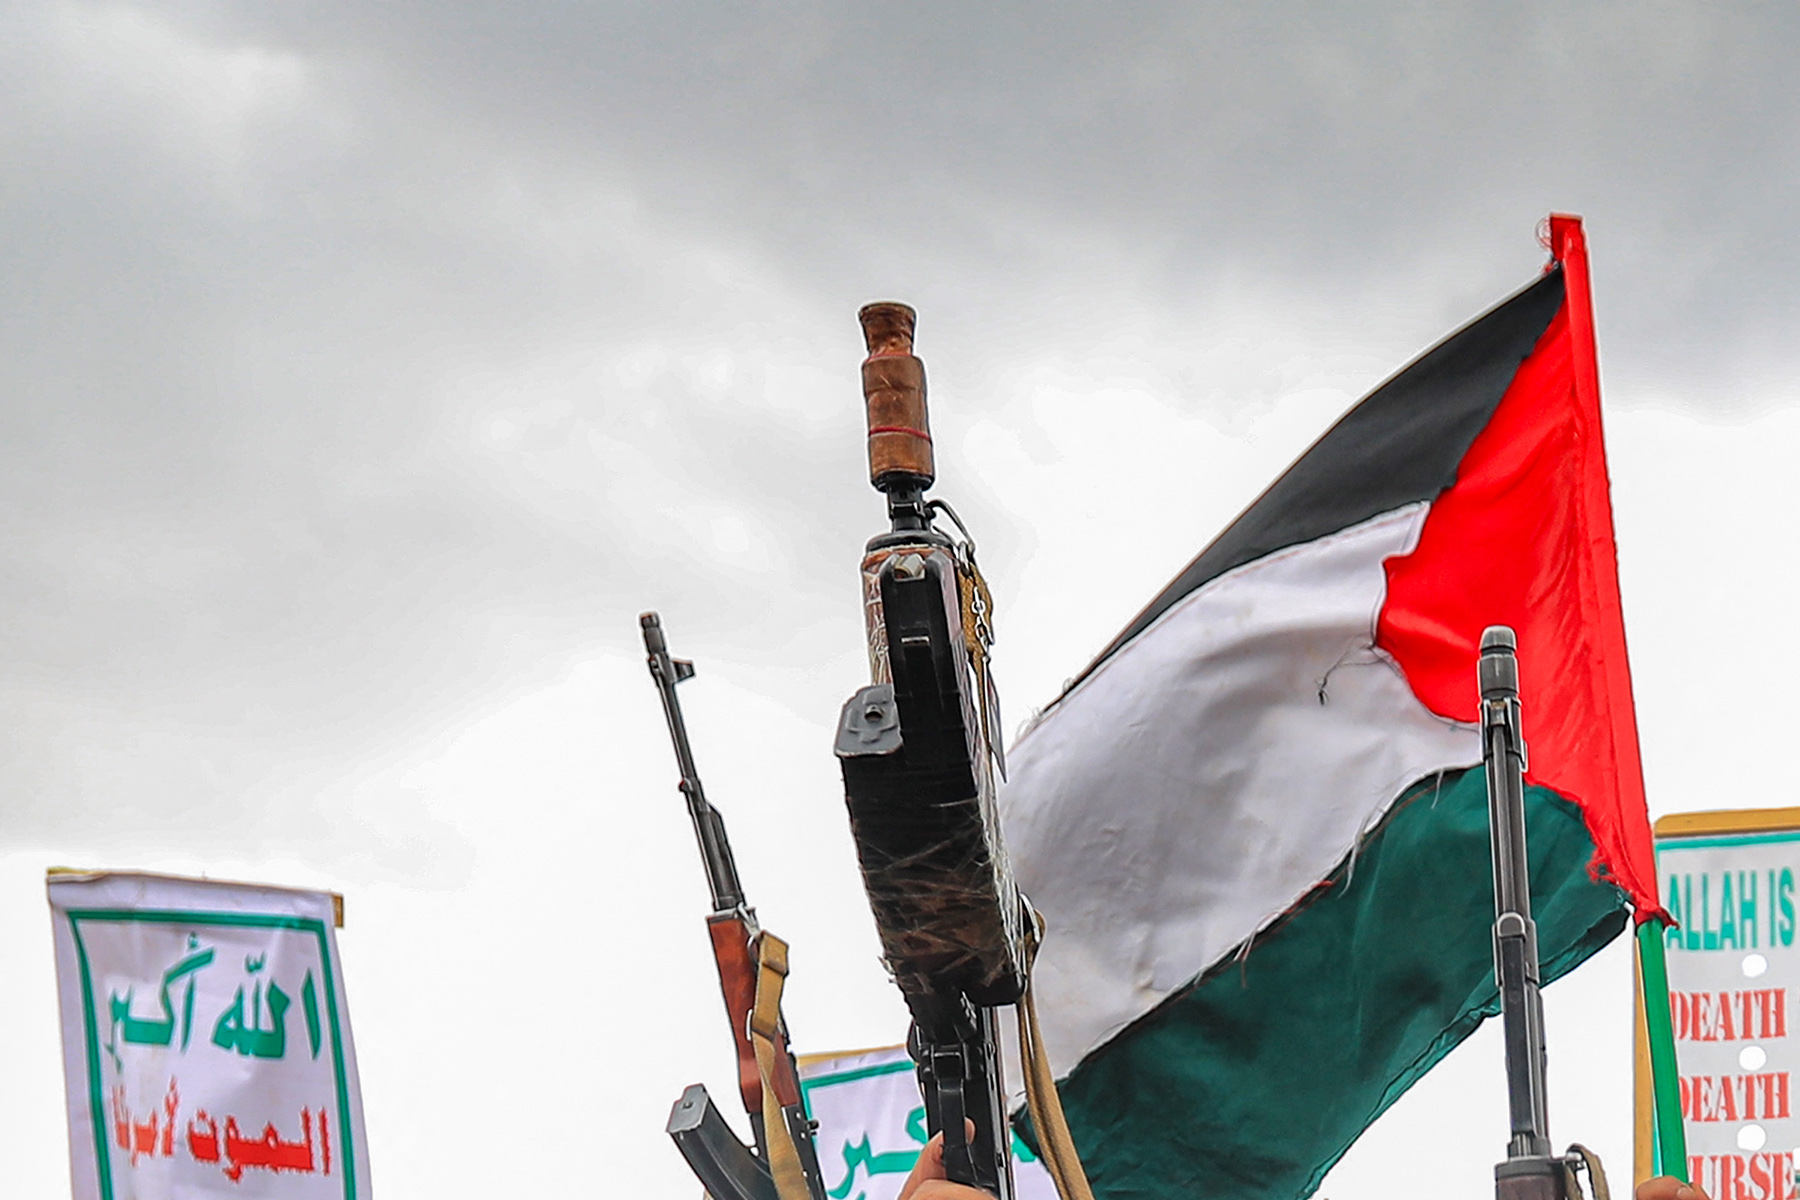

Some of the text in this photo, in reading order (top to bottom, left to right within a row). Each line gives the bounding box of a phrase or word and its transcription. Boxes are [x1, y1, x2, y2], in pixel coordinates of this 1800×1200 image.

[1666, 869, 1758, 951] ALLAH
[1768, 866, 1796, 948] IS
[1668, 987, 1787, 1042] DEATH
[187, 1104, 331, 1182] الموت
